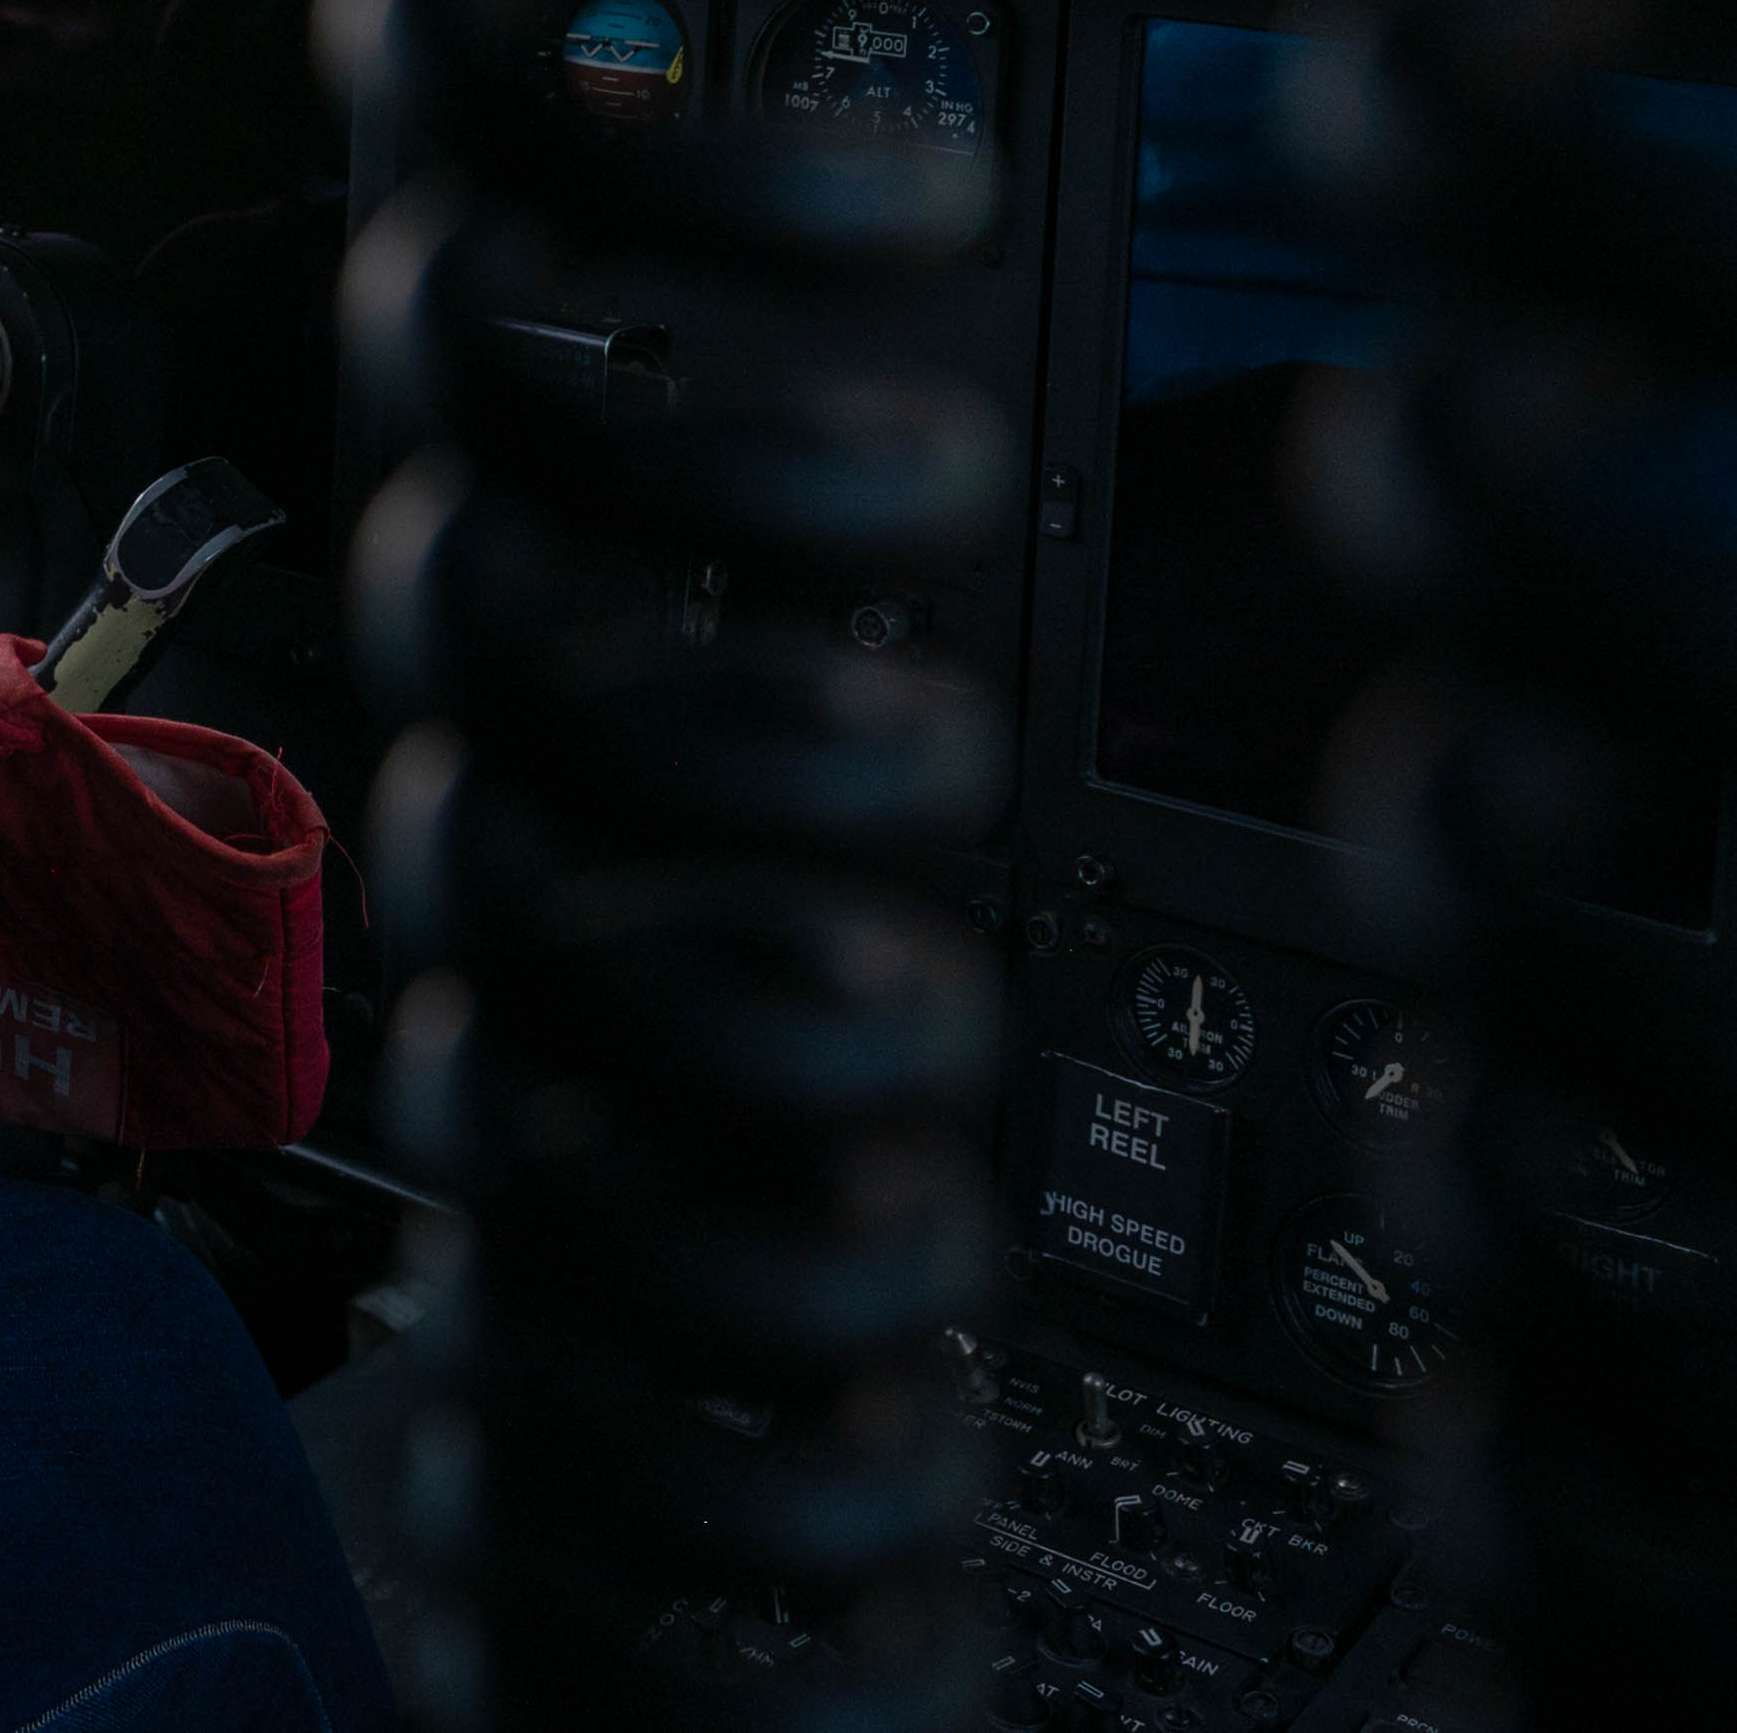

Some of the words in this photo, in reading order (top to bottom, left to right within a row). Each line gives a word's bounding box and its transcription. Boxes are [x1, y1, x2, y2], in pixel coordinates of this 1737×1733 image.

[848, 9, 858, 21] 9
[878, 1, 889, 15] 0
[928, 45, 937, 59] 2
[826, 66, 836, 80] 7
[865, 86, 892, 99] ALT
[925, 79, 935, 94] 3
[841, 96, 851, 109] 6
[903, 106, 913, 117] 4
[1173, 965, 1188, 978] 30
[1210, 976, 1226, 989] 30
[1156, 998, 1165, 1009] 0
[1171, 1021, 1224, 1044] AILON
[1230, 1018, 1238, 1030] 0
[1393, 1032, 1403, 1044] 0
[1167, 1047, 1183, 1060] 30
[1351, 1064, 1367, 1077] 30
[1377, 1089, 1420, 1111] UDDER
[1095, 1093, 1170, 1137] LEFT
[1378, 1103, 1410, 1121] TRIM
[1089, 1122, 1167, 1171] REEL
[1050, 1191, 1104, 1227] HIGH
[1110, 1213, 1186, 1257] SPEED
[1344, 1230, 1365, 1247] UP
[1067, 1224, 1163, 1277] DROGUE
[1393, 1249, 1414, 1267] 20
[1303, 1266, 1364, 1294] PERCENT
[1410, 1279, 1431, 1297] 40
[1302, 1280, 1376, 1313] EXTENDED
[1314, 1303, 1364, 1330] DOWN
[1408, 1306, 1430, 1324] 60
[1389, 1322, 1410, 1340] 80
[1105, 1381, 1148, 1406] LOT
[1140, 1423, 1167, 1440] DIM
[1054, 1449, 1094, 1470] ANN
[1109, 1456, 1142, 1472] BRT
[1151, 1484, 1205, 1512] DOME
[987, 1512, 1040, 1541] PANEL
[1287, 1534, 1329, 1557] BKR
[989, 1534, 1032, 1558] SIDE
[1038, 1553, 1054, 1568] &
[1061, 1562, 1118, 1592] INSTR
[1089, 1552, 1149, 1581] FLOOD
[1195, 1592, 1259, 1624] FLOOR
[1178, 1650, 1220, 1677] AIN
